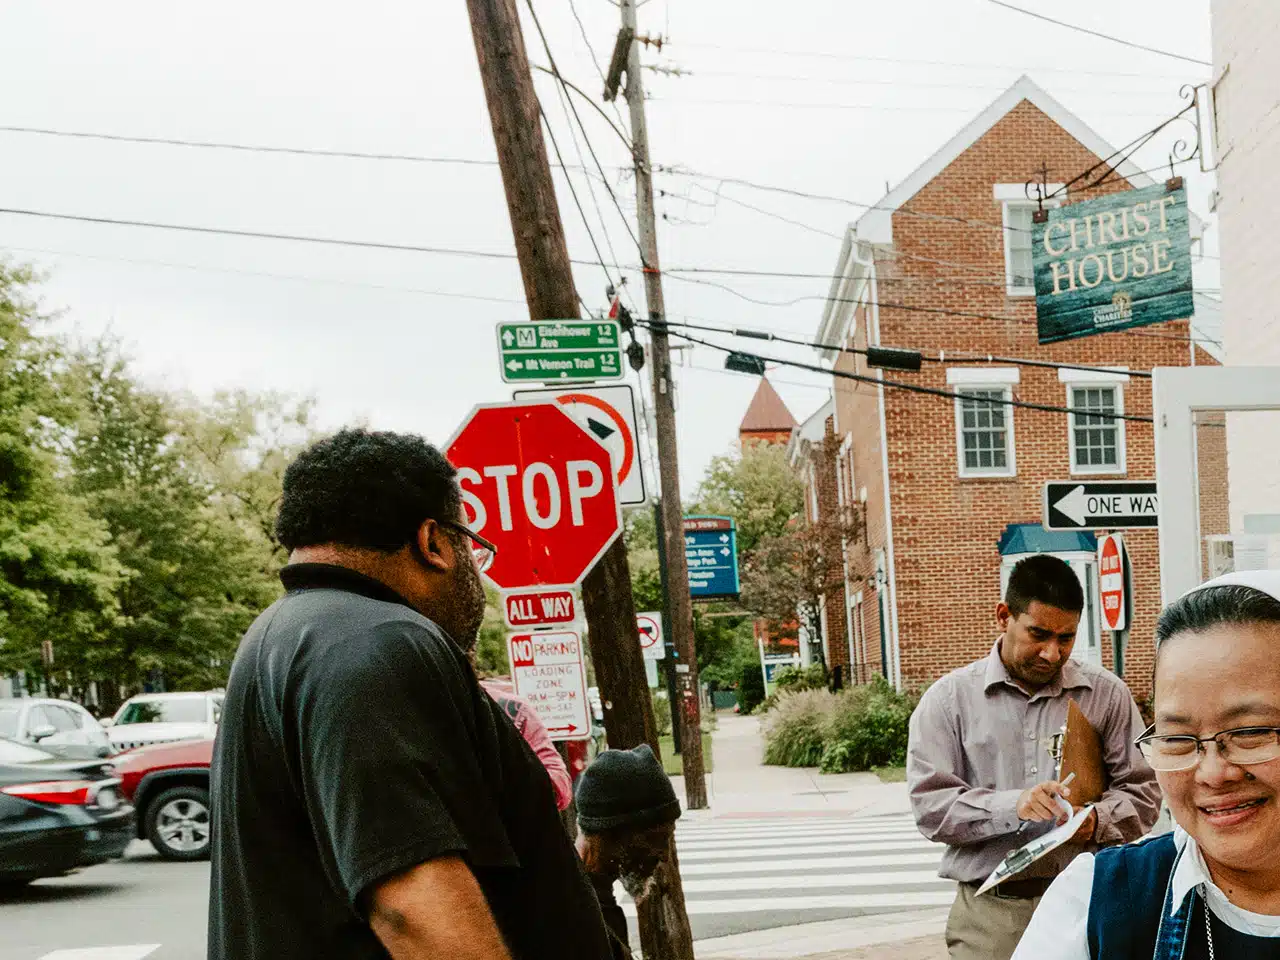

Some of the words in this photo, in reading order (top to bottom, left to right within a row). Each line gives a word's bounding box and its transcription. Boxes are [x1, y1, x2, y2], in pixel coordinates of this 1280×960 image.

[1043, 196, 1176, 257] CHRIST
[1049, 239, 1176, 295] HOUSE
[539, 359, 573, 370] Vernon
[574, 357, 595, 369] Trail
[456, 459, 604, 534] STOP
[1087, 496, 1122, 514] ONE
[509, 599, 538, 621] ALL
[541, 596, 572, 618] WAY
[511, 640, 533, 662] NO
[534, 641, 577, 655] PARKING
[523, 665, 573, 678] LOADING
[536, 679, 564, 690] ZONE
